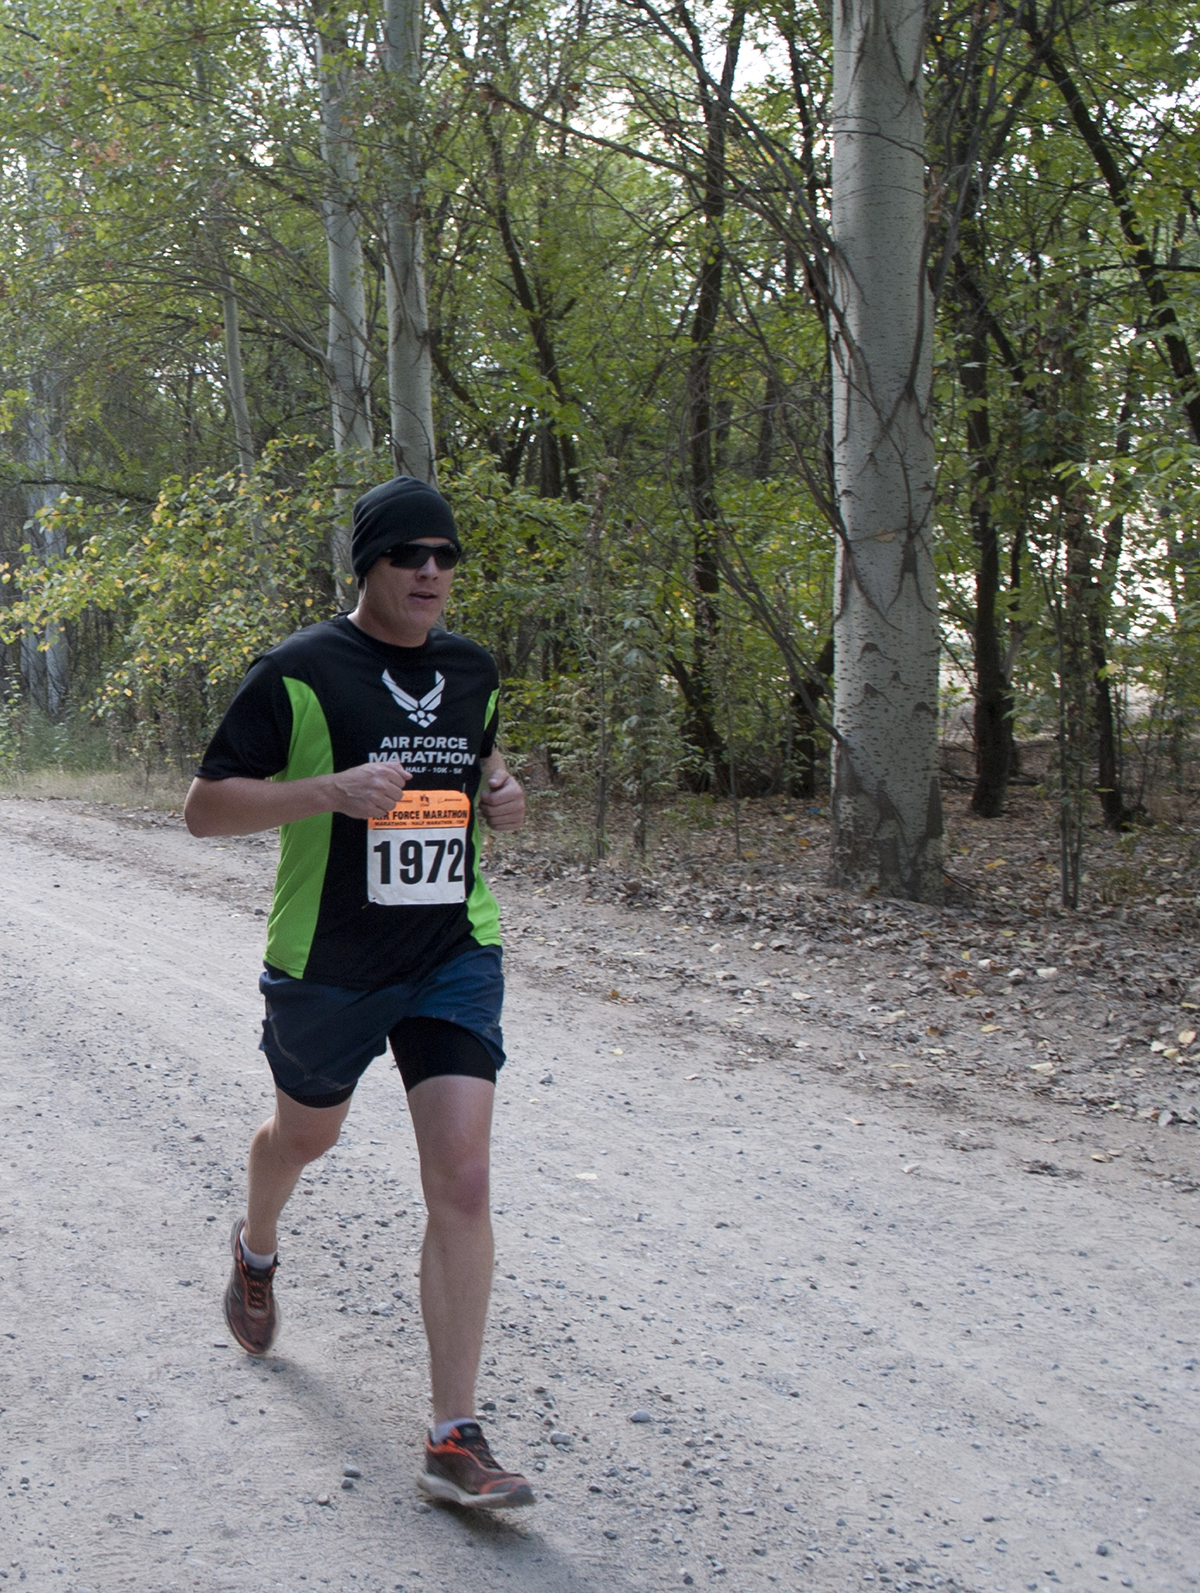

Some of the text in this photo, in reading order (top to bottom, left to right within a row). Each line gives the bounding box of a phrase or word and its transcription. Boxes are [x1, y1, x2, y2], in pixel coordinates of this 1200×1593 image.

[381, 736, 468, 750] AIR FORCE
[368, 752, 476, 765] MARATHON
[392, 811, 420, 820] FORCE
[423, 810, 467, 819] MARATHON
[373, 838, 464, 885] 1972
